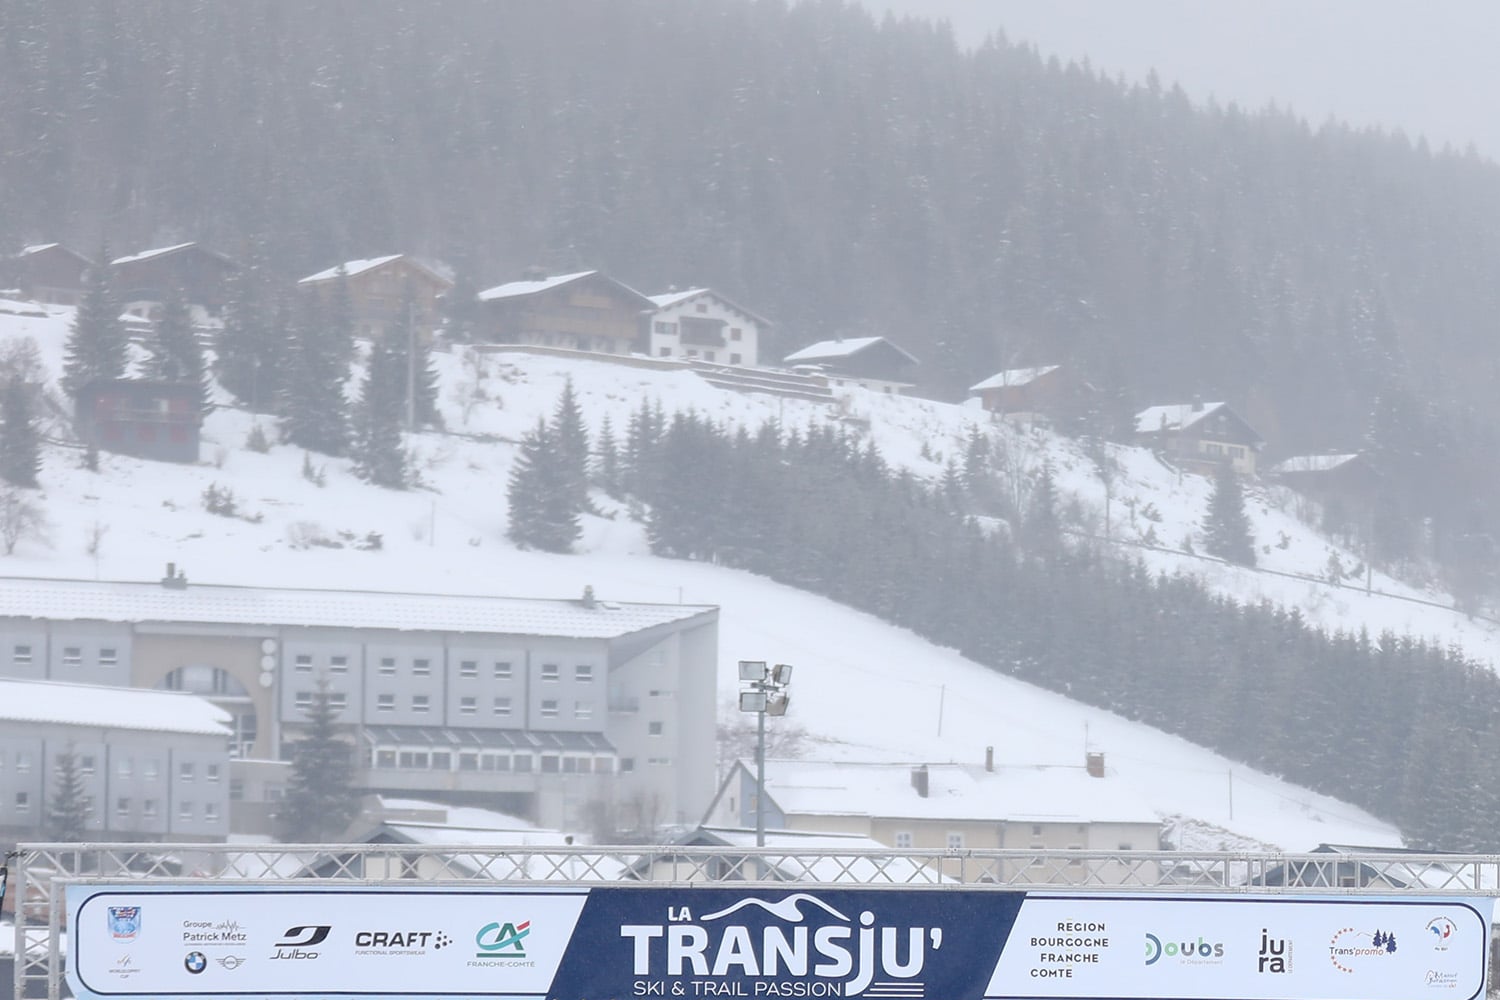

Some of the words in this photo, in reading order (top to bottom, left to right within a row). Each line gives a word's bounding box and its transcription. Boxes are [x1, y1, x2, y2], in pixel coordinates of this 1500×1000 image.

[667, 907, 692, 921] LA
[183, 920, 213, 930] Groupe
[1057, 922, 1106, 932] REGION
[183, 932, 219, 942] Patrick
[222, 932, 247, 942] Metz
[355, 932, 433, 948] CRAFT
[1030, 938, 1109, 947] BOURGOGNE
[1259, 928, 1285, 955] ju
[269, 948, 319, 960] Julbo
[1145, 933, 1224, 965] Doubs
[1329, 946, 1385, 958] Trans'promo
[1040, 953, 1099, 963] FRANCHE
[1258, 956, 1286, 973] ra
[1030, 969, 1073, 978] COMTE
[633, 981, 665, 996] SKI
[670, 981, 686, 996] &
[690, 981, 748, 997] TRAIL
[754, 982, 842, 997] PASSION
